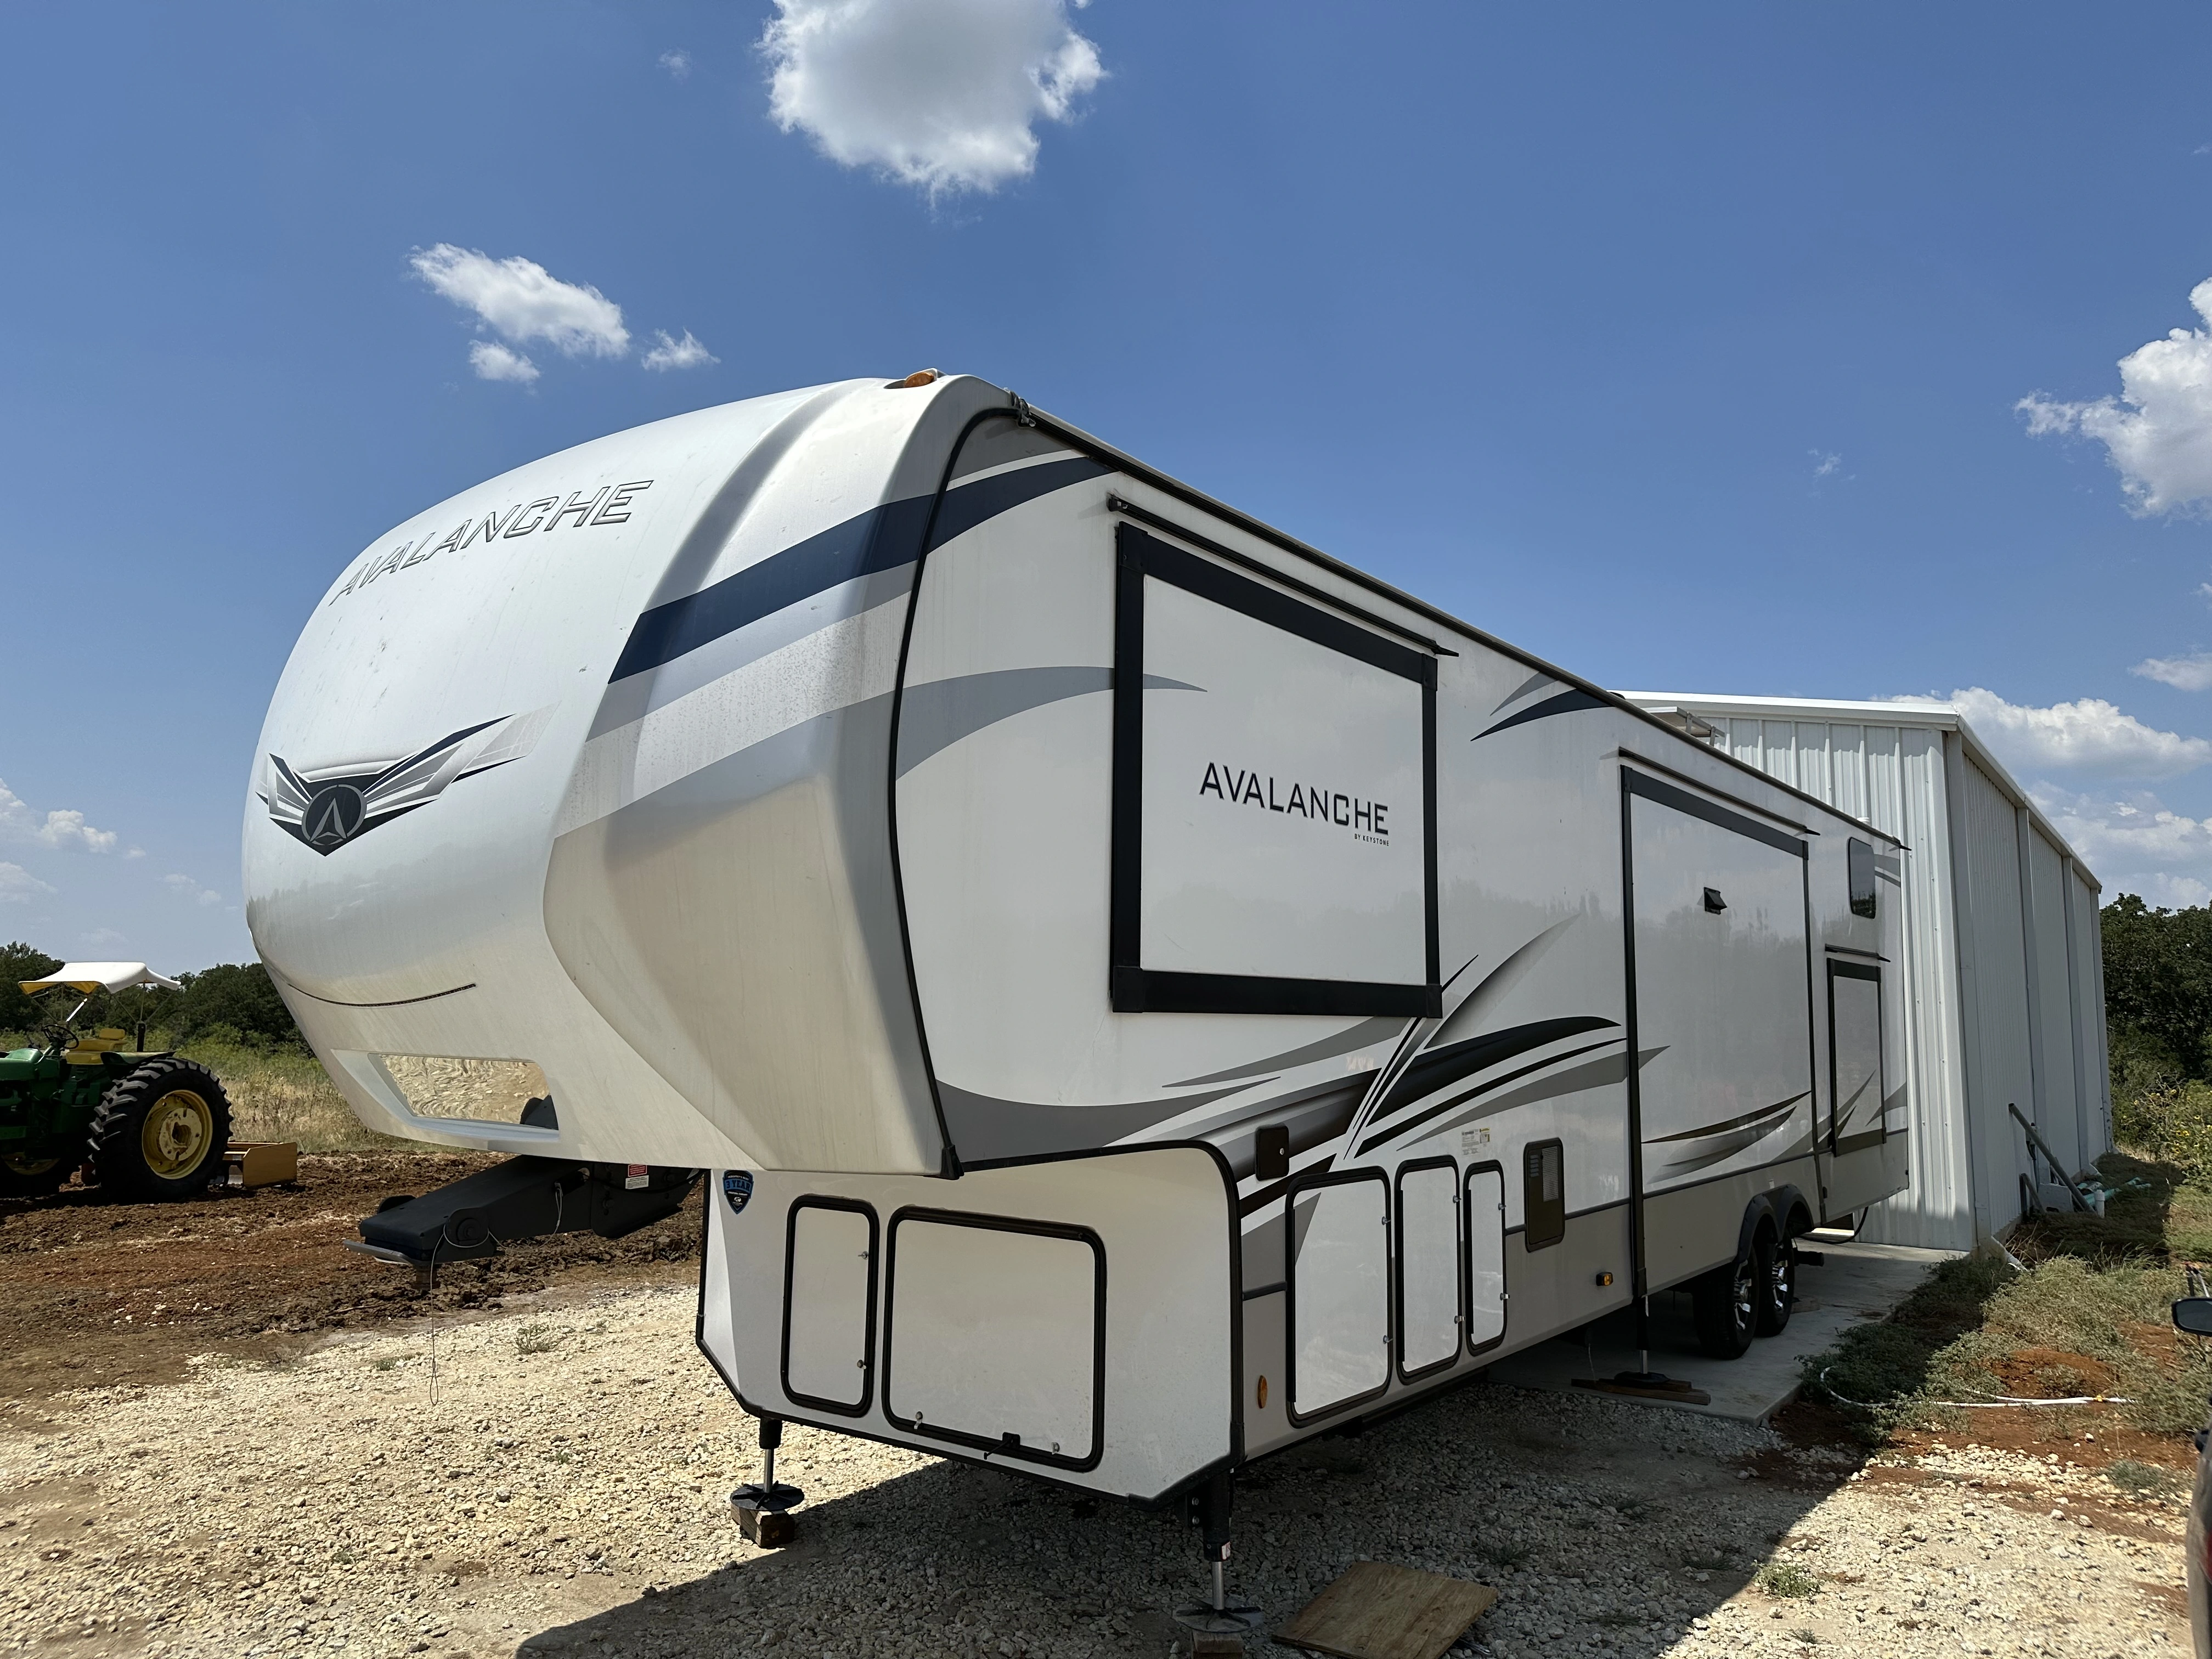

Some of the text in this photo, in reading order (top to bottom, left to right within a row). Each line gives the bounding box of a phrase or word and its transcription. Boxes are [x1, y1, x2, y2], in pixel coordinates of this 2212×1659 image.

[329, 480, 653, 606] AVALANCHE
[1199, 761, 1389, 835] AVALANCHE
[1363, 835, 1389, 847] KEYSTONE
[726, 1180, 750, 1192] 3 YEAR
